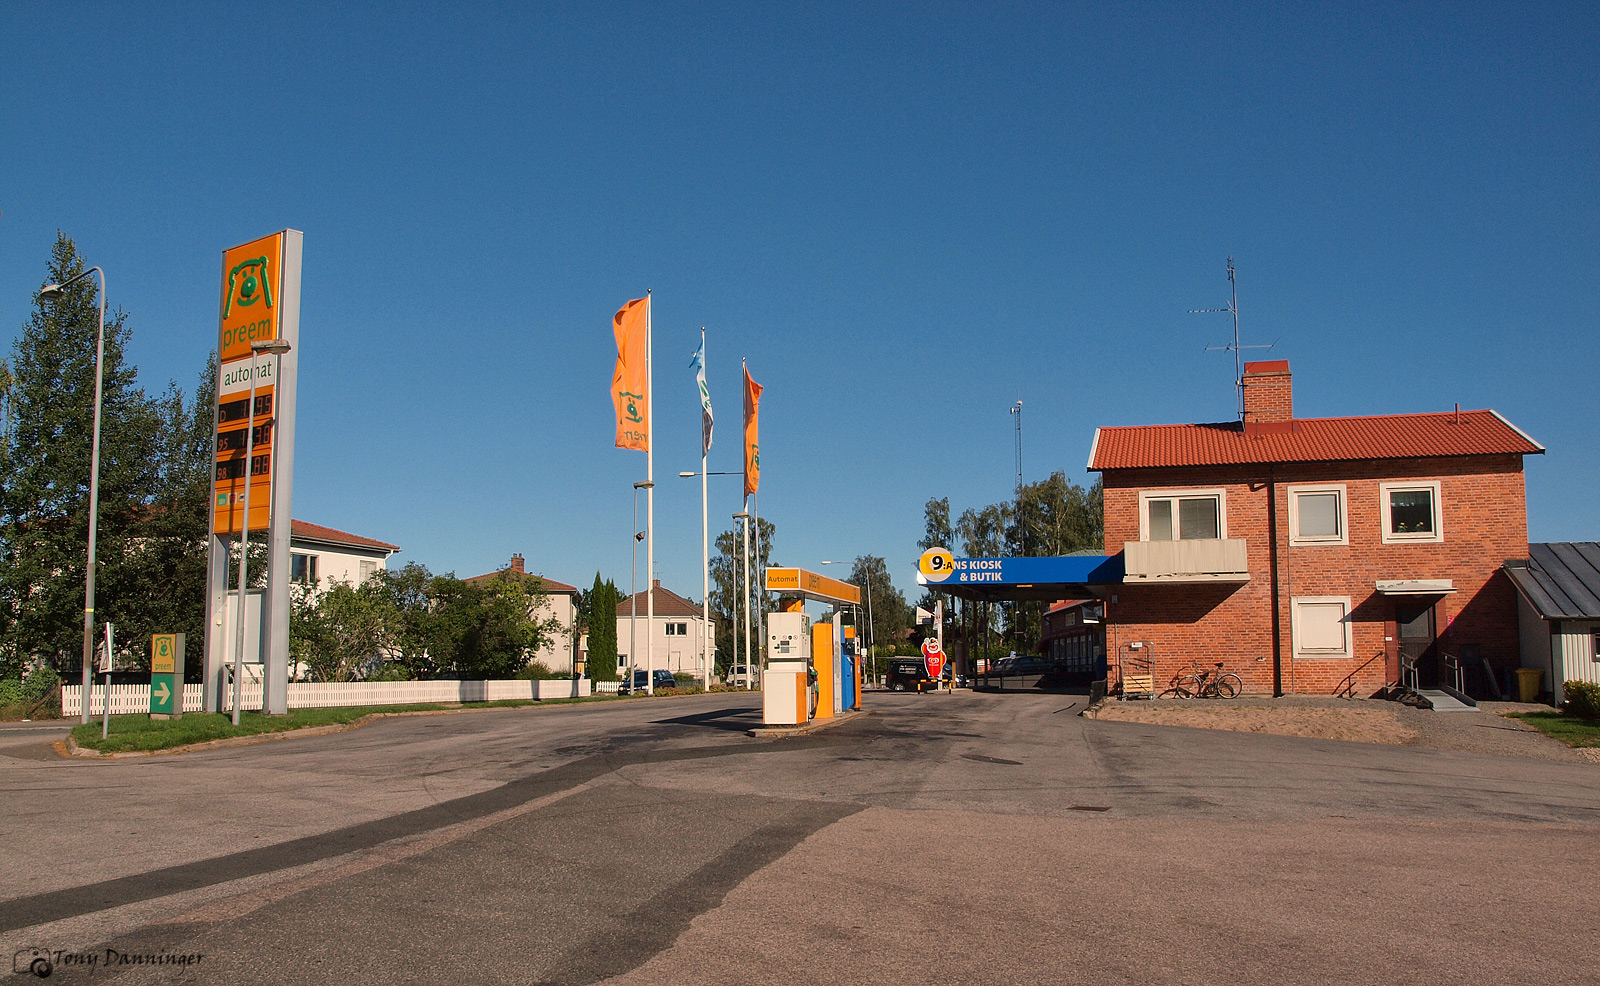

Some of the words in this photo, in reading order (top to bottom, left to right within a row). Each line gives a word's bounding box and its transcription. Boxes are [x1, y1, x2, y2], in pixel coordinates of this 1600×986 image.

[223, 318, 271, 351] preem
[218, 438, 229, 452] 95
[217, 467, 227, 480] 98
[969, 560, 1003, 570] KIOSK
[959, 573, 968, 582] &
[970, 572, 1003, 582] BUTIK
